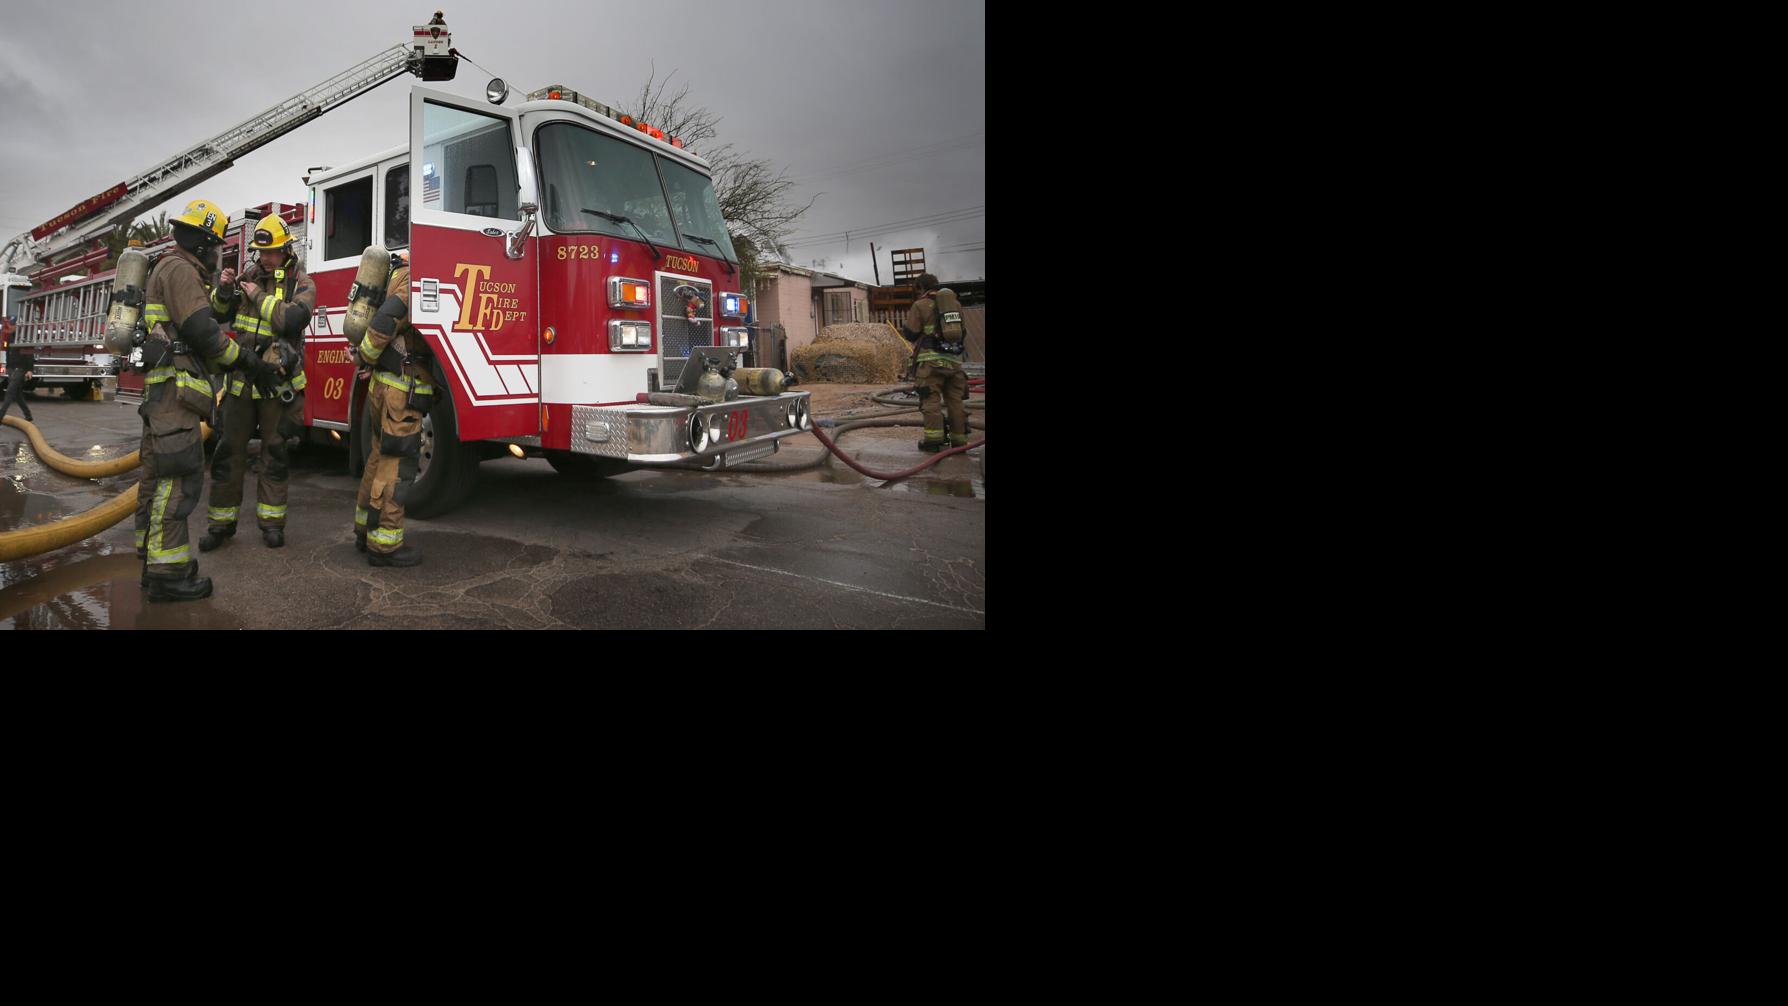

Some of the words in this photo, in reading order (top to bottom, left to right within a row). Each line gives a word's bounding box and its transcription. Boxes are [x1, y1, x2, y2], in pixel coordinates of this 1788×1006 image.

[39, 204, 86, 231] Tucson
[91, 187, 119, 204] Fire
[207, 212, 216, 220] EN
[557, 245, 599, 260] 8723
[666, 255, 700, 273] TUCSON
[453, 263, 516, 330] TUCSON
[473, 293, 519, 330] FIRE
[489, 309, 527, 331] DEPT
[324, 377, 345, 400] 03
[728, 408, 749, 442] 03
